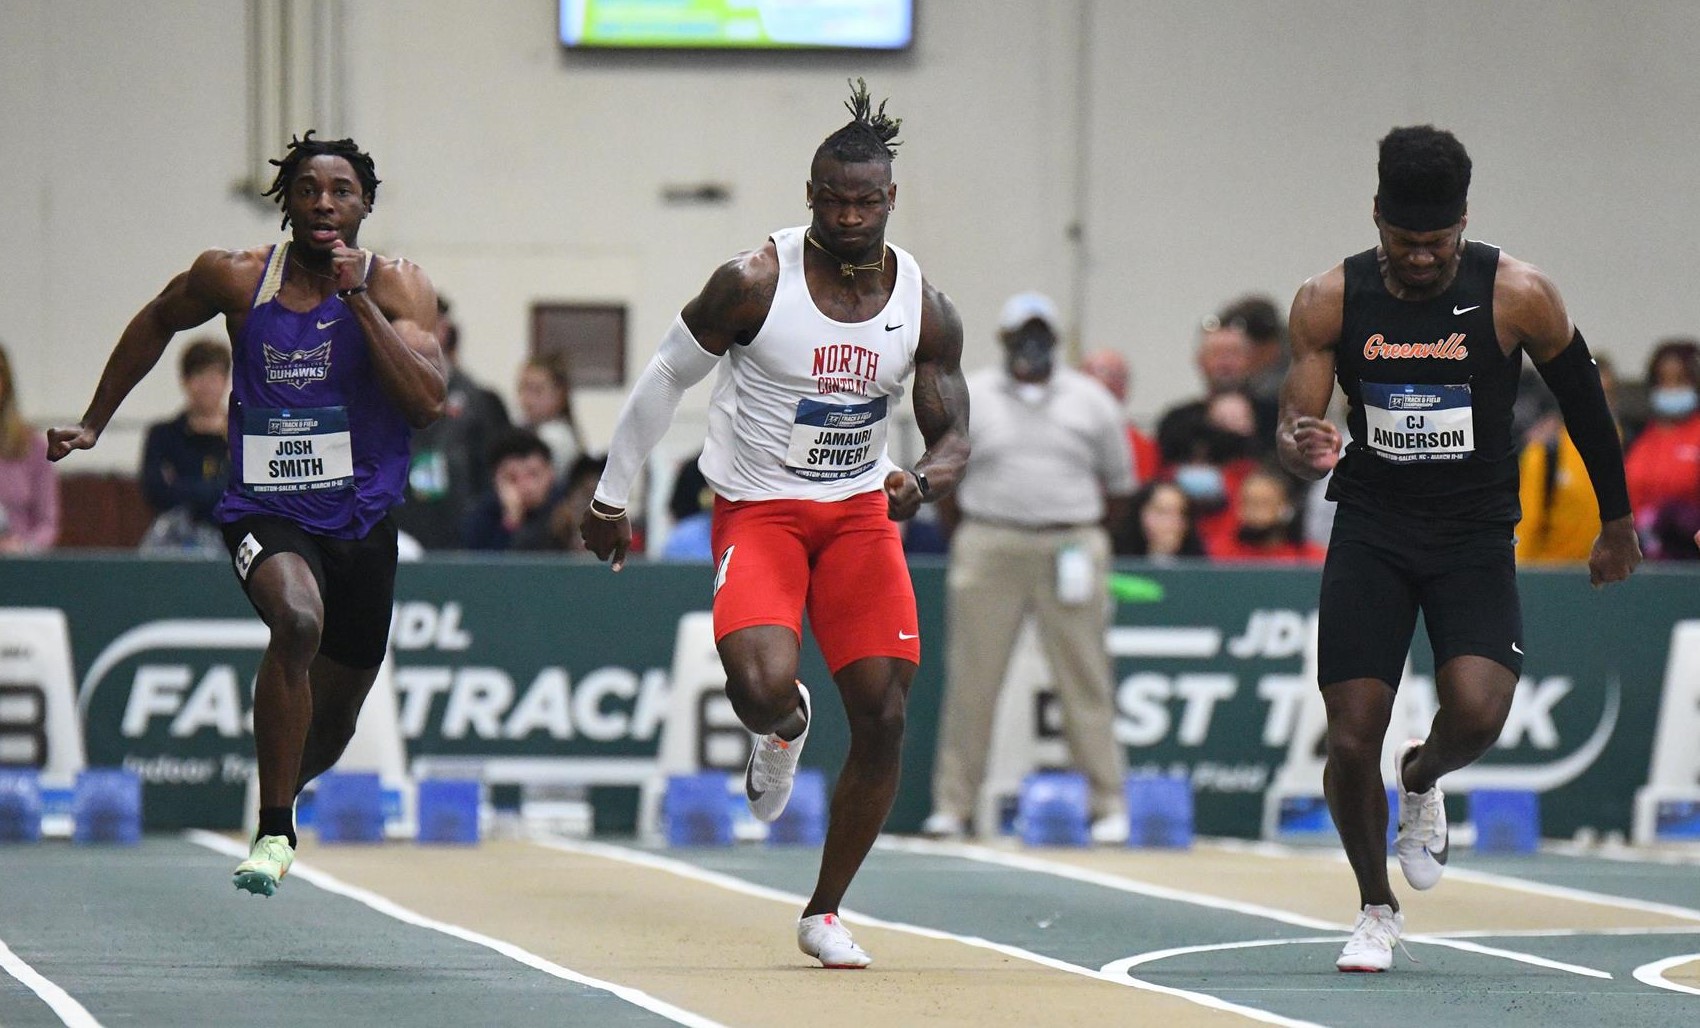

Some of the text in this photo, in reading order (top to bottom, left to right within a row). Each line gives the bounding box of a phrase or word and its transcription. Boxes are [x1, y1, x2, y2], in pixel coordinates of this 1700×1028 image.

[1363, 332, 1469, 361] Greenville
[269, 366, 325, 380] DUHAWKS
[812, 344, 880, 382] NORTH
[1404, 396, 1422, 404] TRACK
[1406, 415, 1425, 429] CJ
[275, 439, 313, 456] JOSH
[814, 428, 873, 447] JAMAURI
[1373, 427, 1465, 449] ANDERSON
[806, 443, 871, 466] SPIVERY
[268, 457, 324, 478] SMITH
[393, 601, 472, 650] DL
[1228, 609, 1316, 659] JD
[121, 664, 254, 739] FA
[1108, 671, 1238, 748] ST
